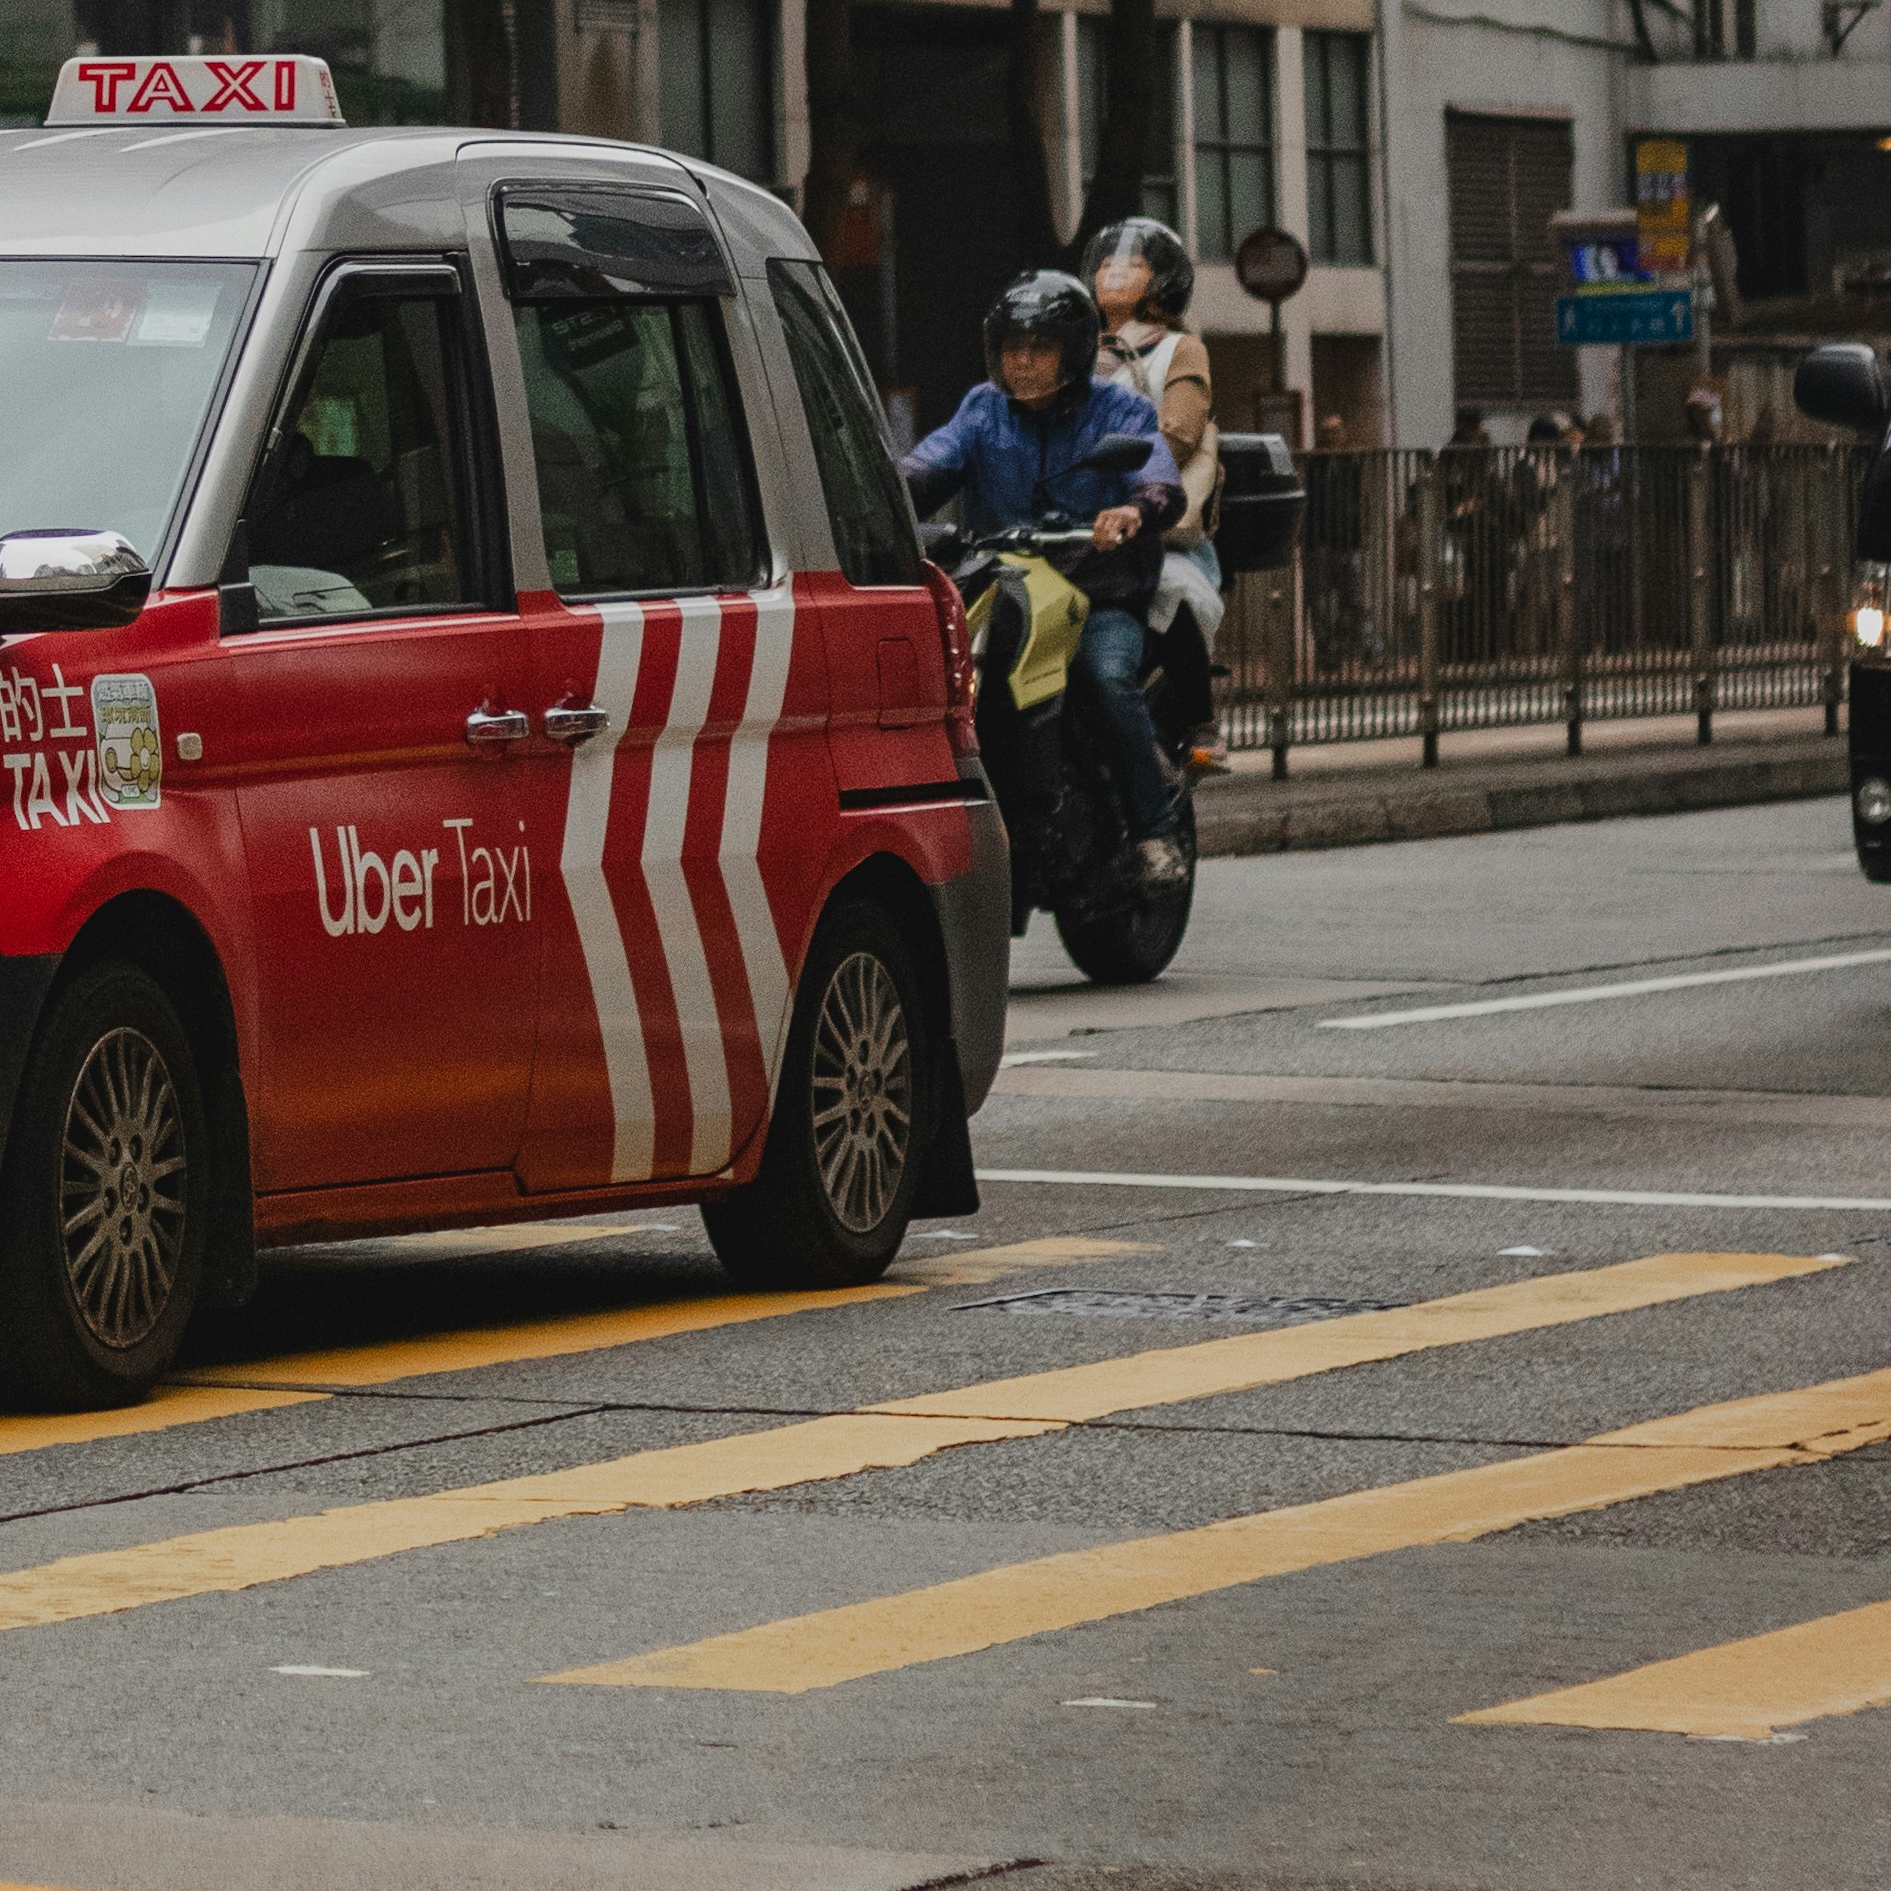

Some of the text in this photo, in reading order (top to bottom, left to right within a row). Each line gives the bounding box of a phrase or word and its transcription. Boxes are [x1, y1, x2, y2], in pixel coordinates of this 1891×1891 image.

[78, 61, 296, 113] TAXI
[3, 750, 111, 831] TAXI
[309, 818, 531, 937] Uber Taxi
